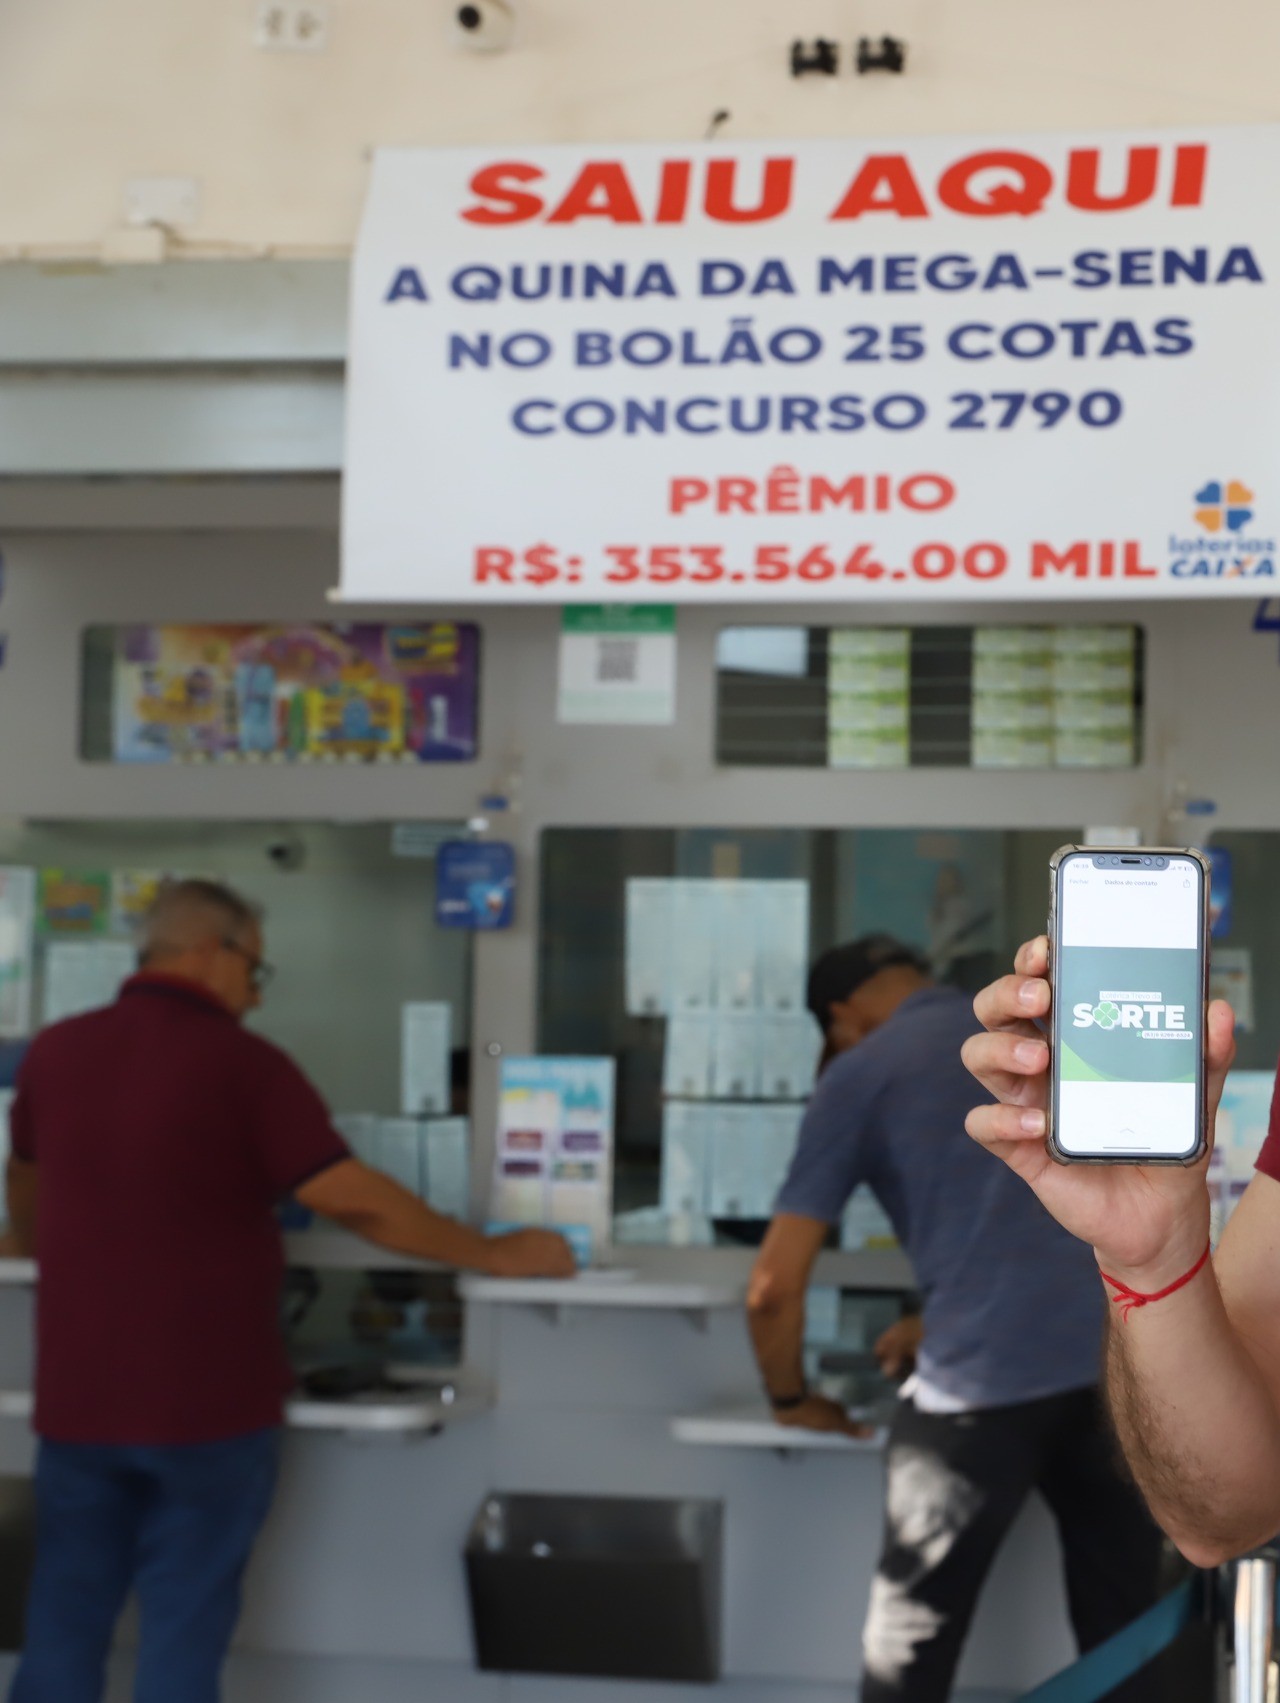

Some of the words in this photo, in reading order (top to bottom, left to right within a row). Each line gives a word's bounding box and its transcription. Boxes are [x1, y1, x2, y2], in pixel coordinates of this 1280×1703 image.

[458, 156, 797, 229] SAIU
[828, 142, 1211, 223] AQUI
[384, 265, 430, 304] A
[448, 261, 679, 303] QUINA
[698, 257, 797, 298] DA
[817, 244, 1266, 295] MEGA-SENA
[447, 331, 553, 370] NO
[573, 316, 825, 368] BOLÃO
[843, 323, 927, 364] 25
[945, 316, 1196, 362] COTAS
[510, 393, 928, 438] CONCURSO
[947, 389, 1125, 431] 2790
[668, 464, 957, 515] PRÊMIO
[473, 544, 582, 586] R$:
[604, 542, 1009, 585] 353.564.00
[1030, 540, 1159, 580] MIL
[1169, 534, 1276, 554] loterias
[1170, 557, 1274, 579] CAIXA
